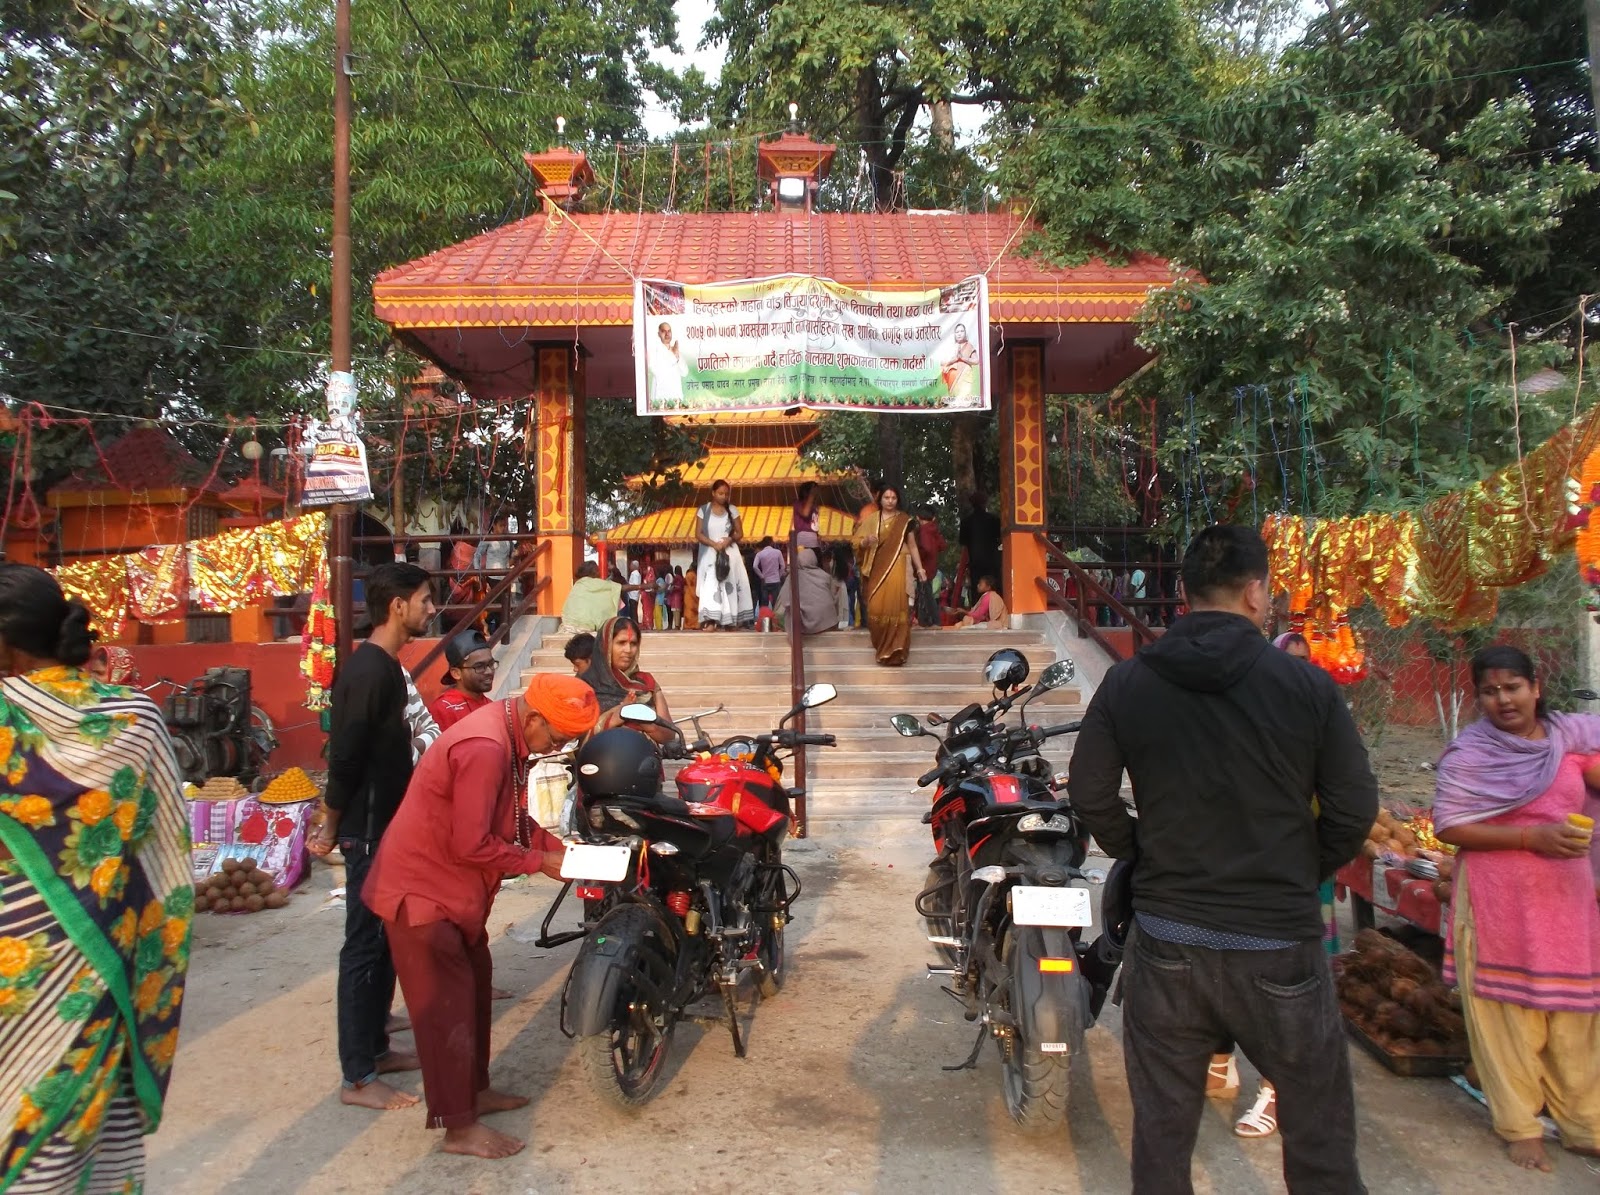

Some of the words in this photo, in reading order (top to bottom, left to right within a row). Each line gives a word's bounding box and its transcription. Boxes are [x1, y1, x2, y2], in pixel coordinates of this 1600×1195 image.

[740, 299, 764, 313] महान
[886, 306, 902, 319] तथा
[905, 305, 920, 319] छठ
[922, 302, 935, 315] पर्व
[686, 325, 704, 340] २०७५
[706, 321, 717, 338] को
[718, 324, 737, 338] पावन
[738, 322, 769, 339] अवसरमा
[698, 353, 731, 371] प्रगतिको
[732, 355, 763, 369] कामना
[779, 349, 802, 368] हार्दिक
[836, 352, 878, 371] शुभकामना
[879, 357, 901, 371] व्यक्त
[716, 379, 731, 390] यादव
